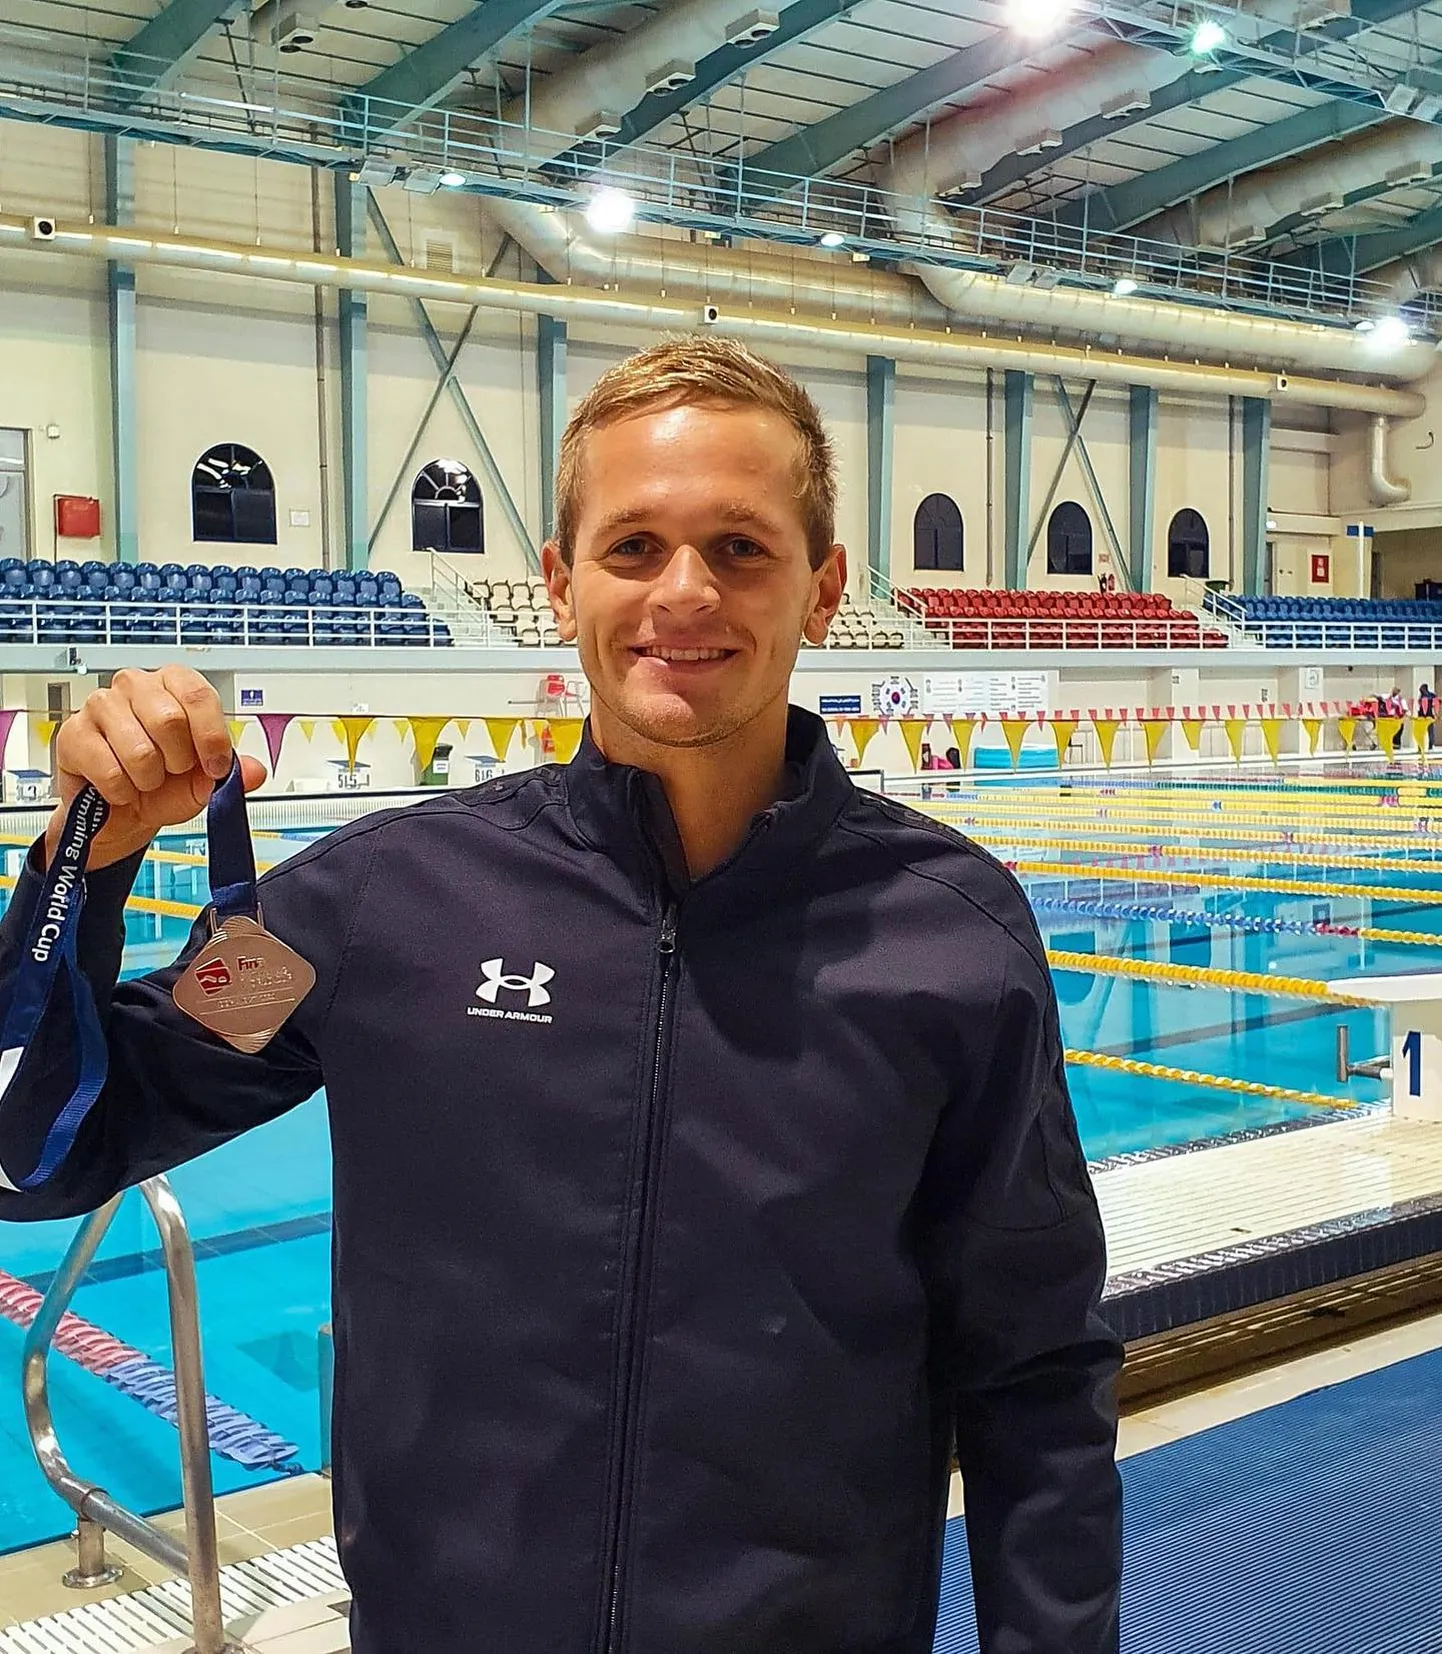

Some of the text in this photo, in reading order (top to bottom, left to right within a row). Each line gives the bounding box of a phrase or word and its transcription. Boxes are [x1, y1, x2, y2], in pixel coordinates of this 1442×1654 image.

[46, 864, 78, 922] World
[32, 922, 60, 962] Cup
[467, 1006, 553, 1024] UNDER ARMOUR
[1402, 1030, 1421, 1096] 1
